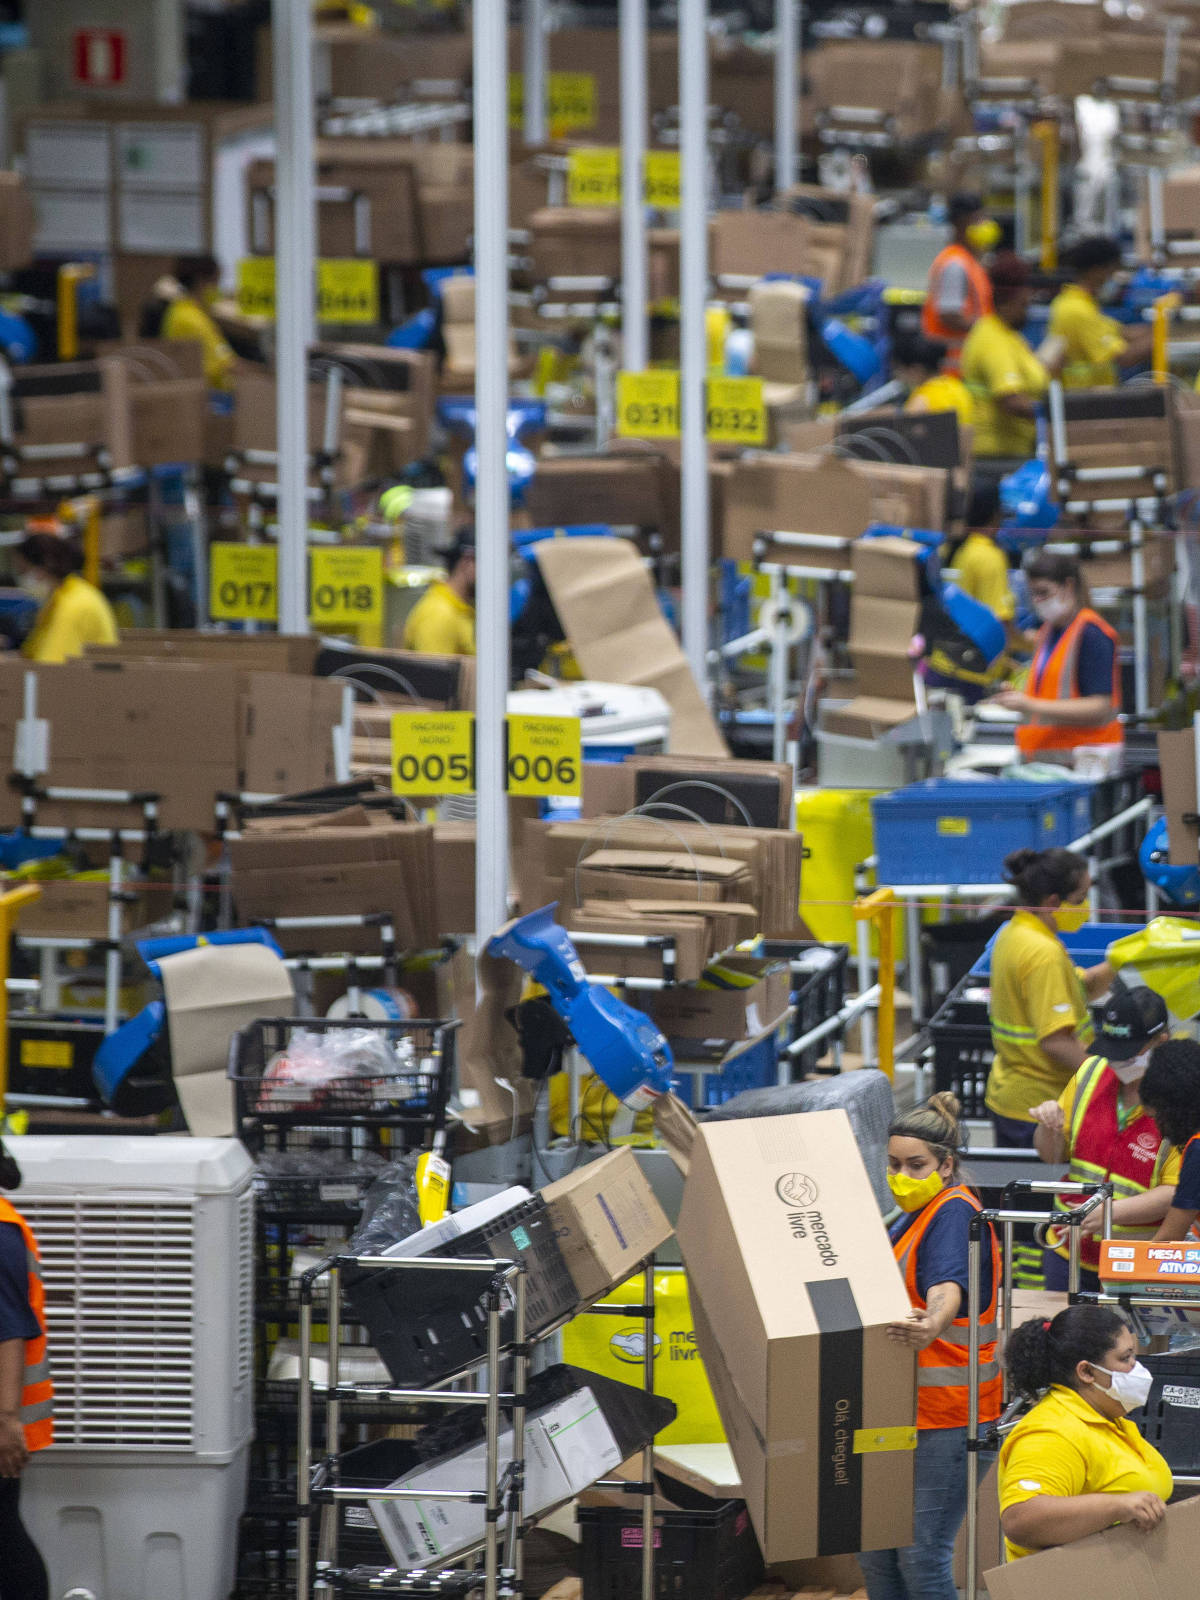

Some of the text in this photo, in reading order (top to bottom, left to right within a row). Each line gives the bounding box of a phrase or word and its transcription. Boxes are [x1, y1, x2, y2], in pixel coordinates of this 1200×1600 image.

[625, 402, 674, 425] 031
[706, 407, 759, 431] 032
[219, 580, 272, 608] 017
[315, 583, 373, 612] 018
[397, 754, 470, 782] 005
[509, 754, 577, 784] 006
[786, 1211, 808, 1239] livre
[806, 1210, 839, 1267] mercado
[1148, 1248, 1183, 1261] MESA
[670, 1345, 699, 1361] livr
[833, 1399, 850, 1426] Olá,
